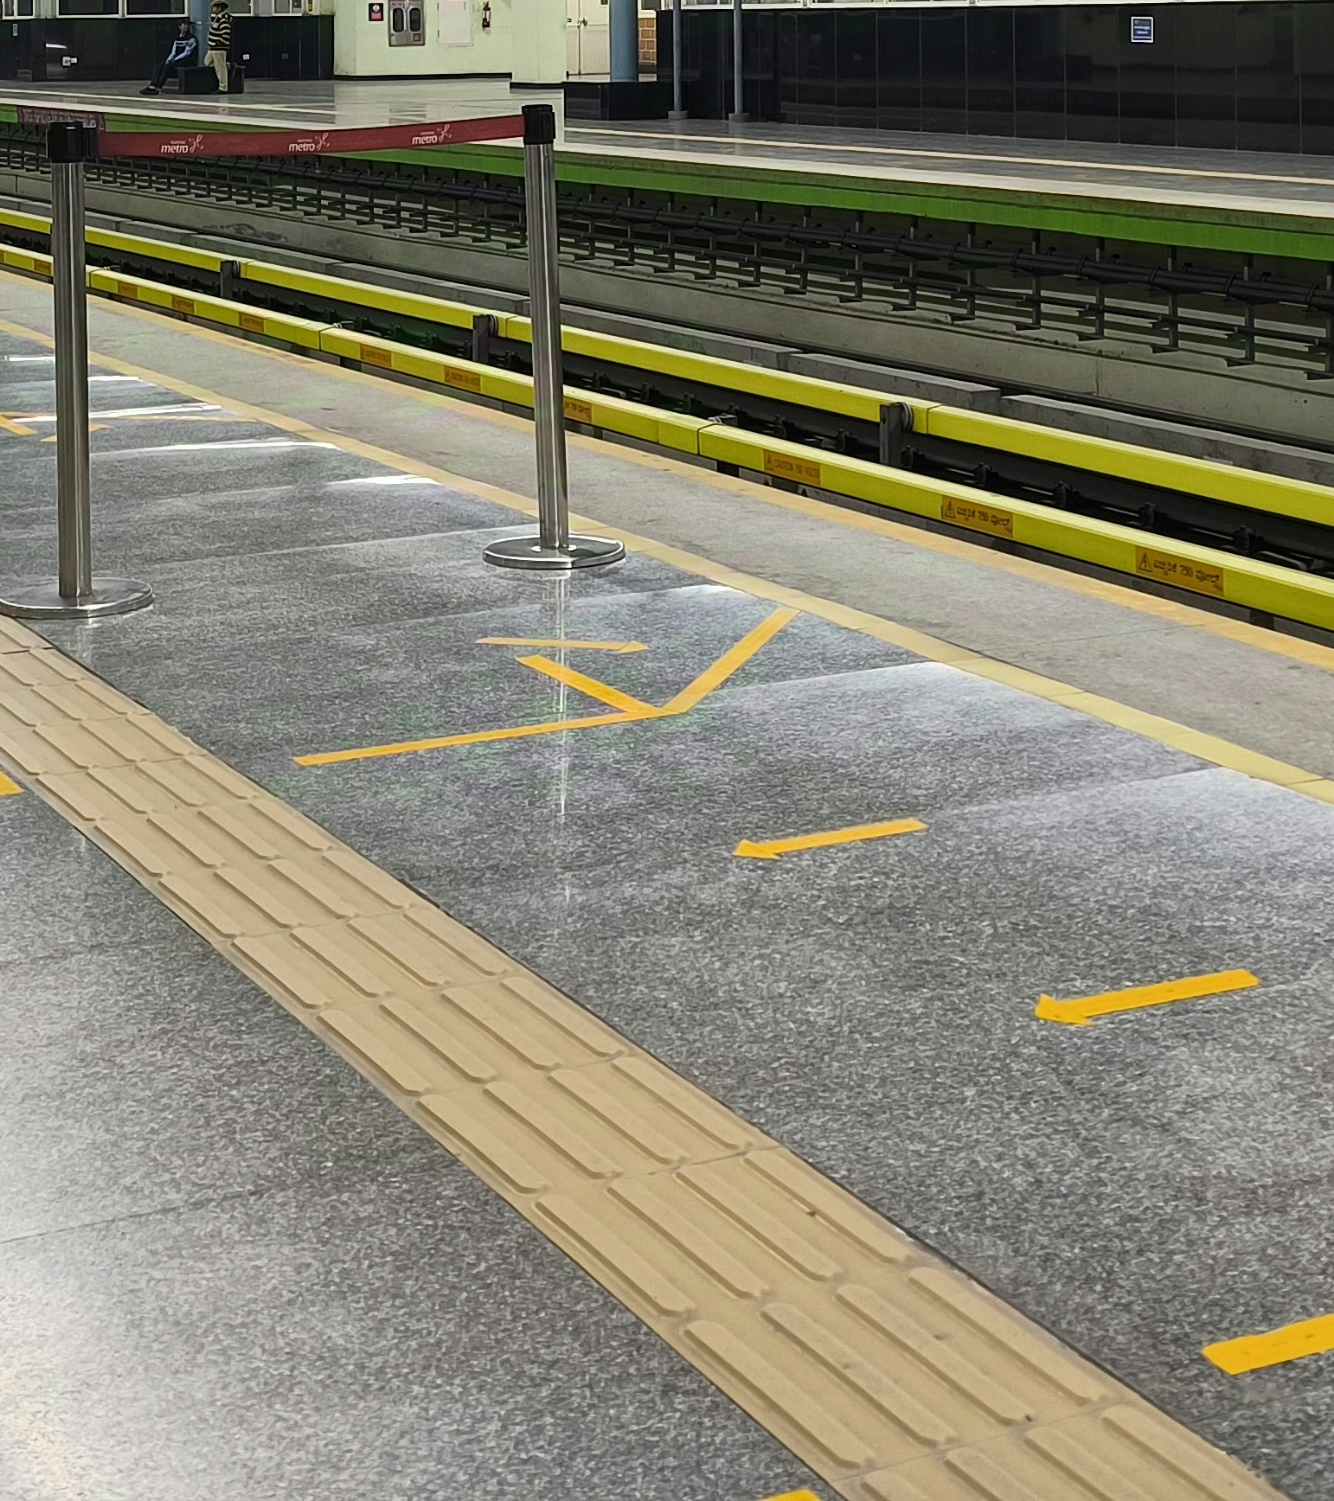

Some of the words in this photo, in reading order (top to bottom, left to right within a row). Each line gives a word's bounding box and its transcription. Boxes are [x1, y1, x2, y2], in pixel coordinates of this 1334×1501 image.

[412, 134, 438, 146] metro
[161, 144, 189, 154] metro
[289, 143, 316, 153] metro
[1179, 564, 1193, 577] 750
